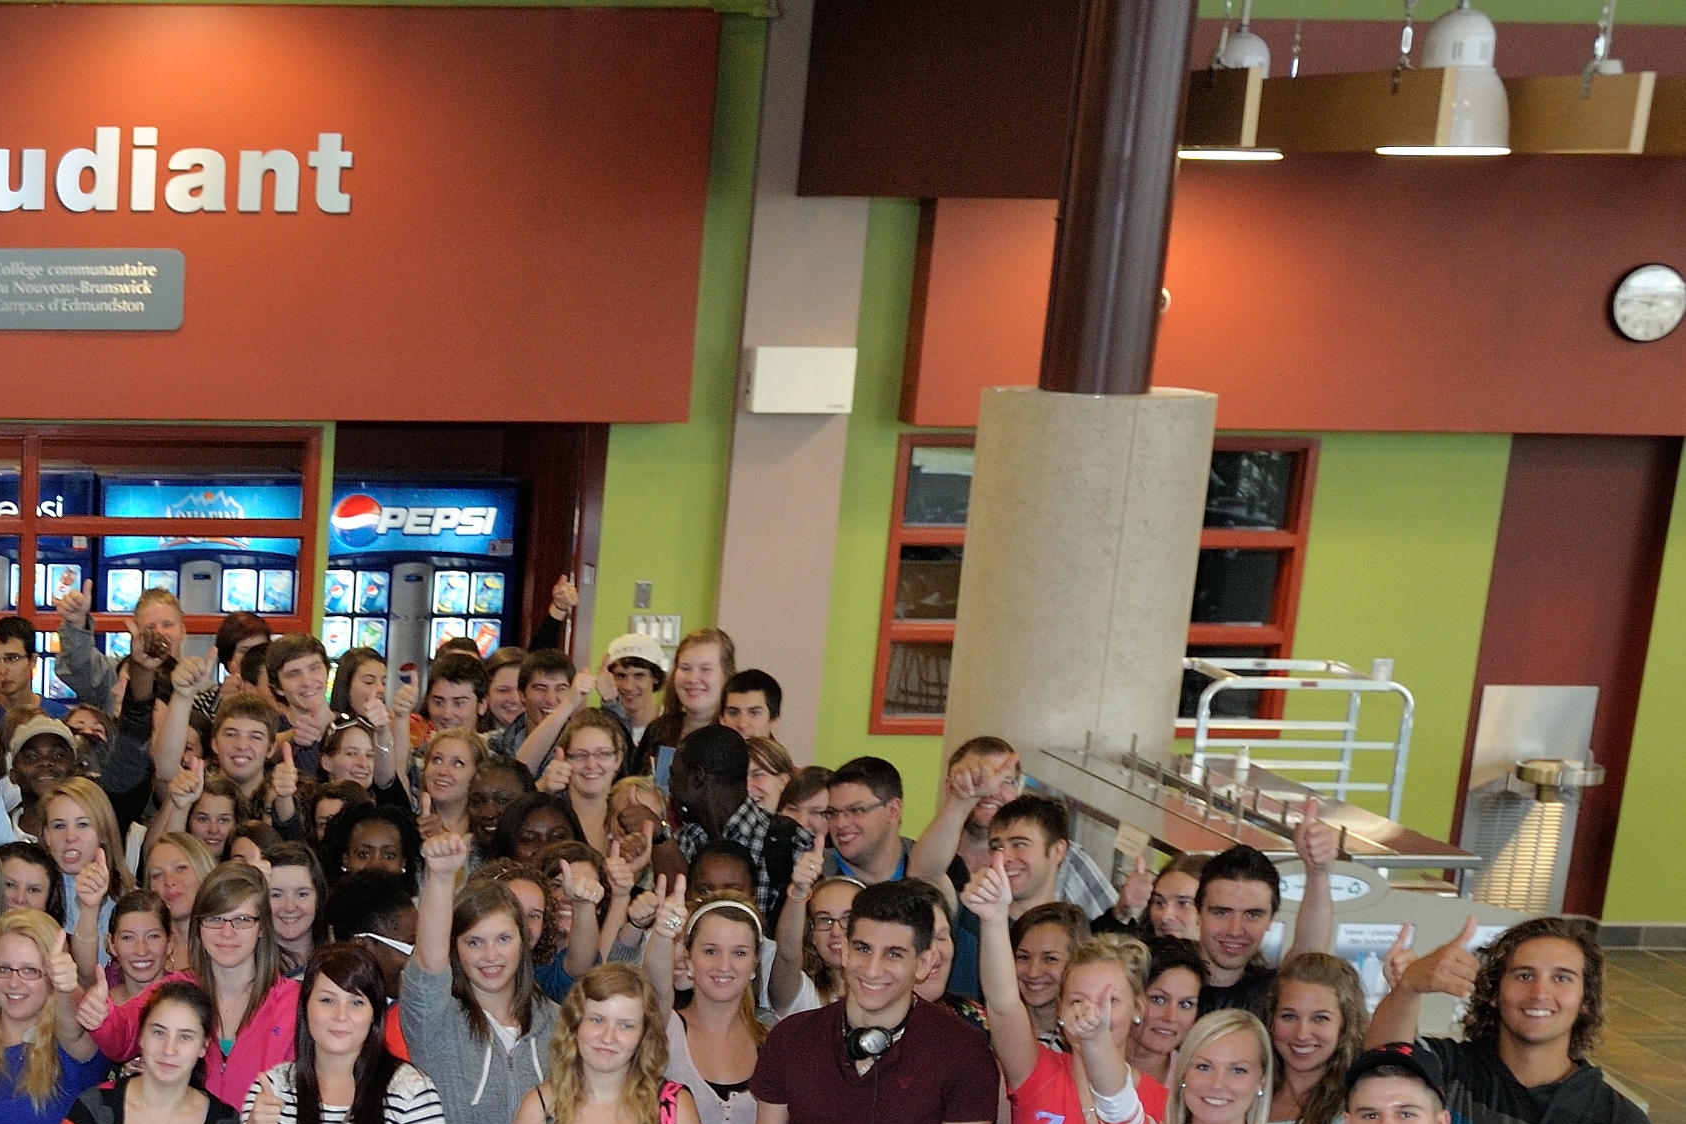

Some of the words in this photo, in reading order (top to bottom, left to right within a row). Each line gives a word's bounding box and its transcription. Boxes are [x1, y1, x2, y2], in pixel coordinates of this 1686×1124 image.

[47, 262, 158, 276] communautaire
[13, 279, 153, 295] Nouveau-Brunswick
[48, 297, 145, 312] d'Edmundston
[376, 506, 498, 536] PEPSI
